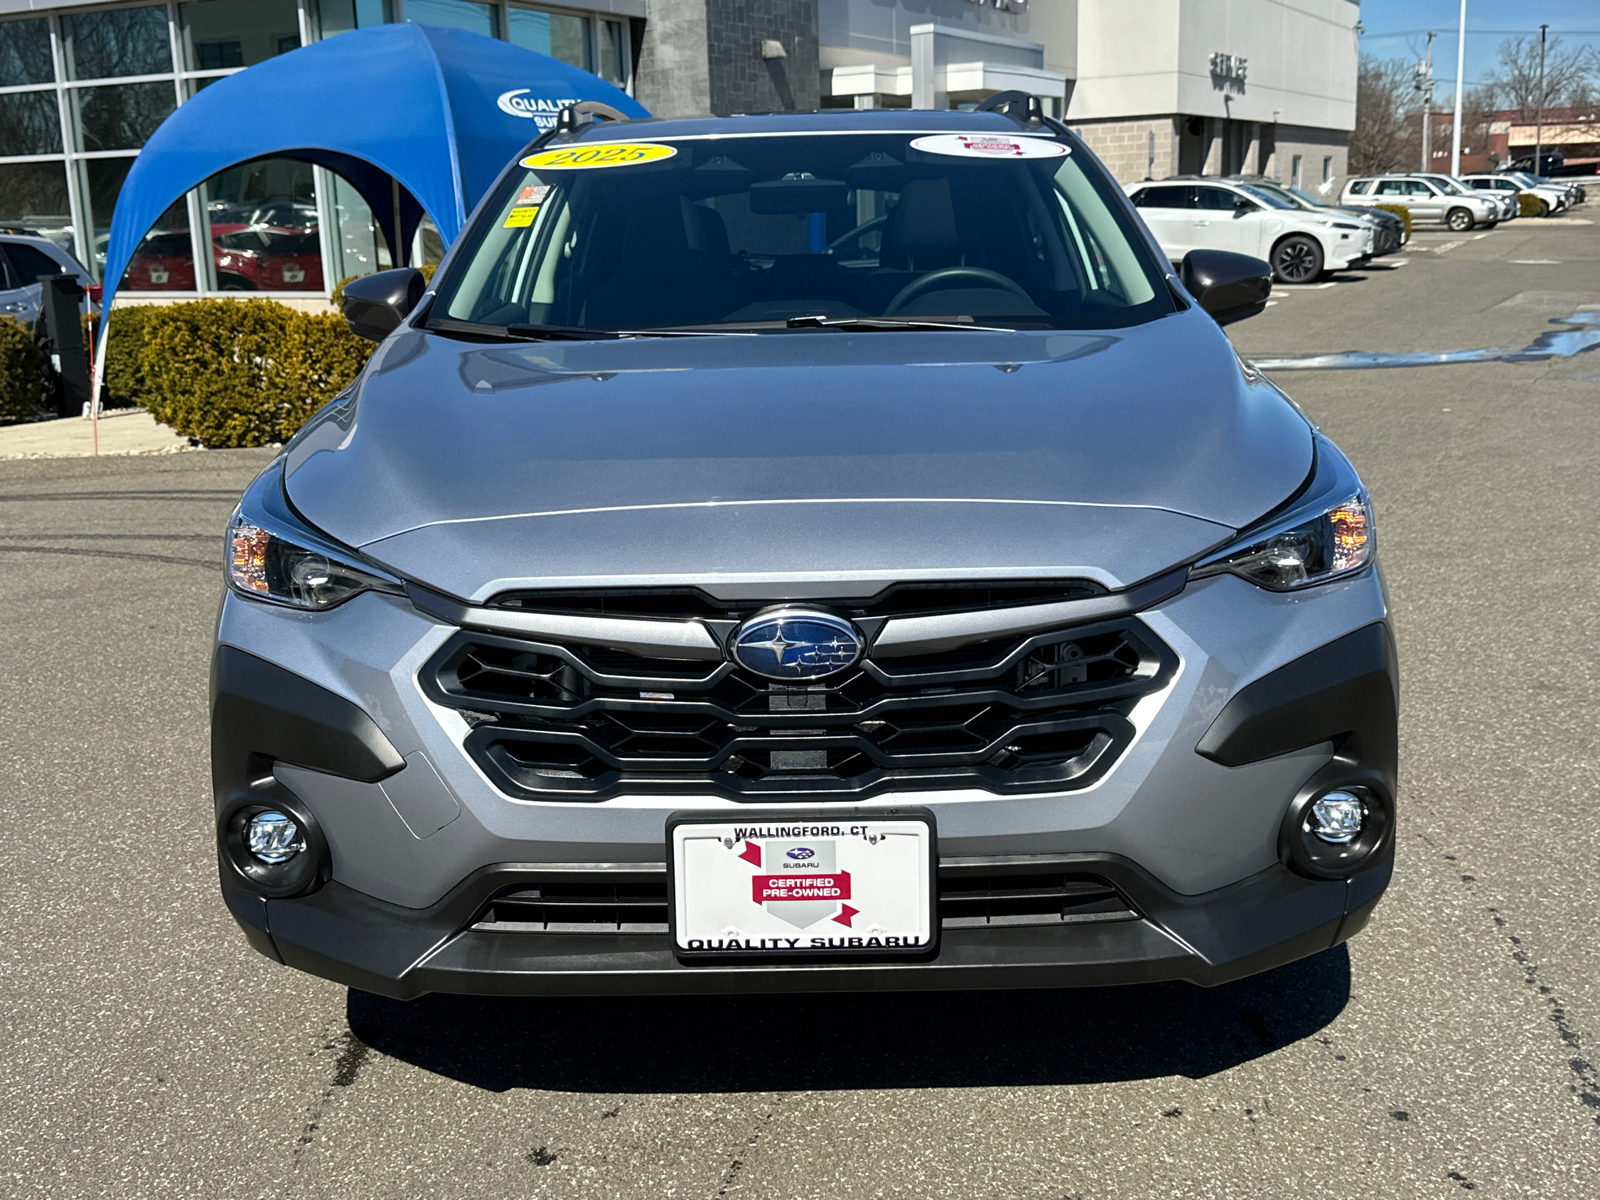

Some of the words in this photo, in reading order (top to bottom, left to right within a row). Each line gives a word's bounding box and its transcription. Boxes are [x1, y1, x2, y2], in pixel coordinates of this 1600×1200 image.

[511, 97, 582, 111] QUALIT
[544, 147, 652, 166] 2025
[734, 826, 845, 838] WALLINGFORD,
[850, 826, 868, 836] CT
[769, 878, 834, 888] CERTIFIED
[763, 887, 841, 898] PRE-OWNED
[687, 938, 800, 950] QUALITY
[810, 935, 920, 949] SUBARU
